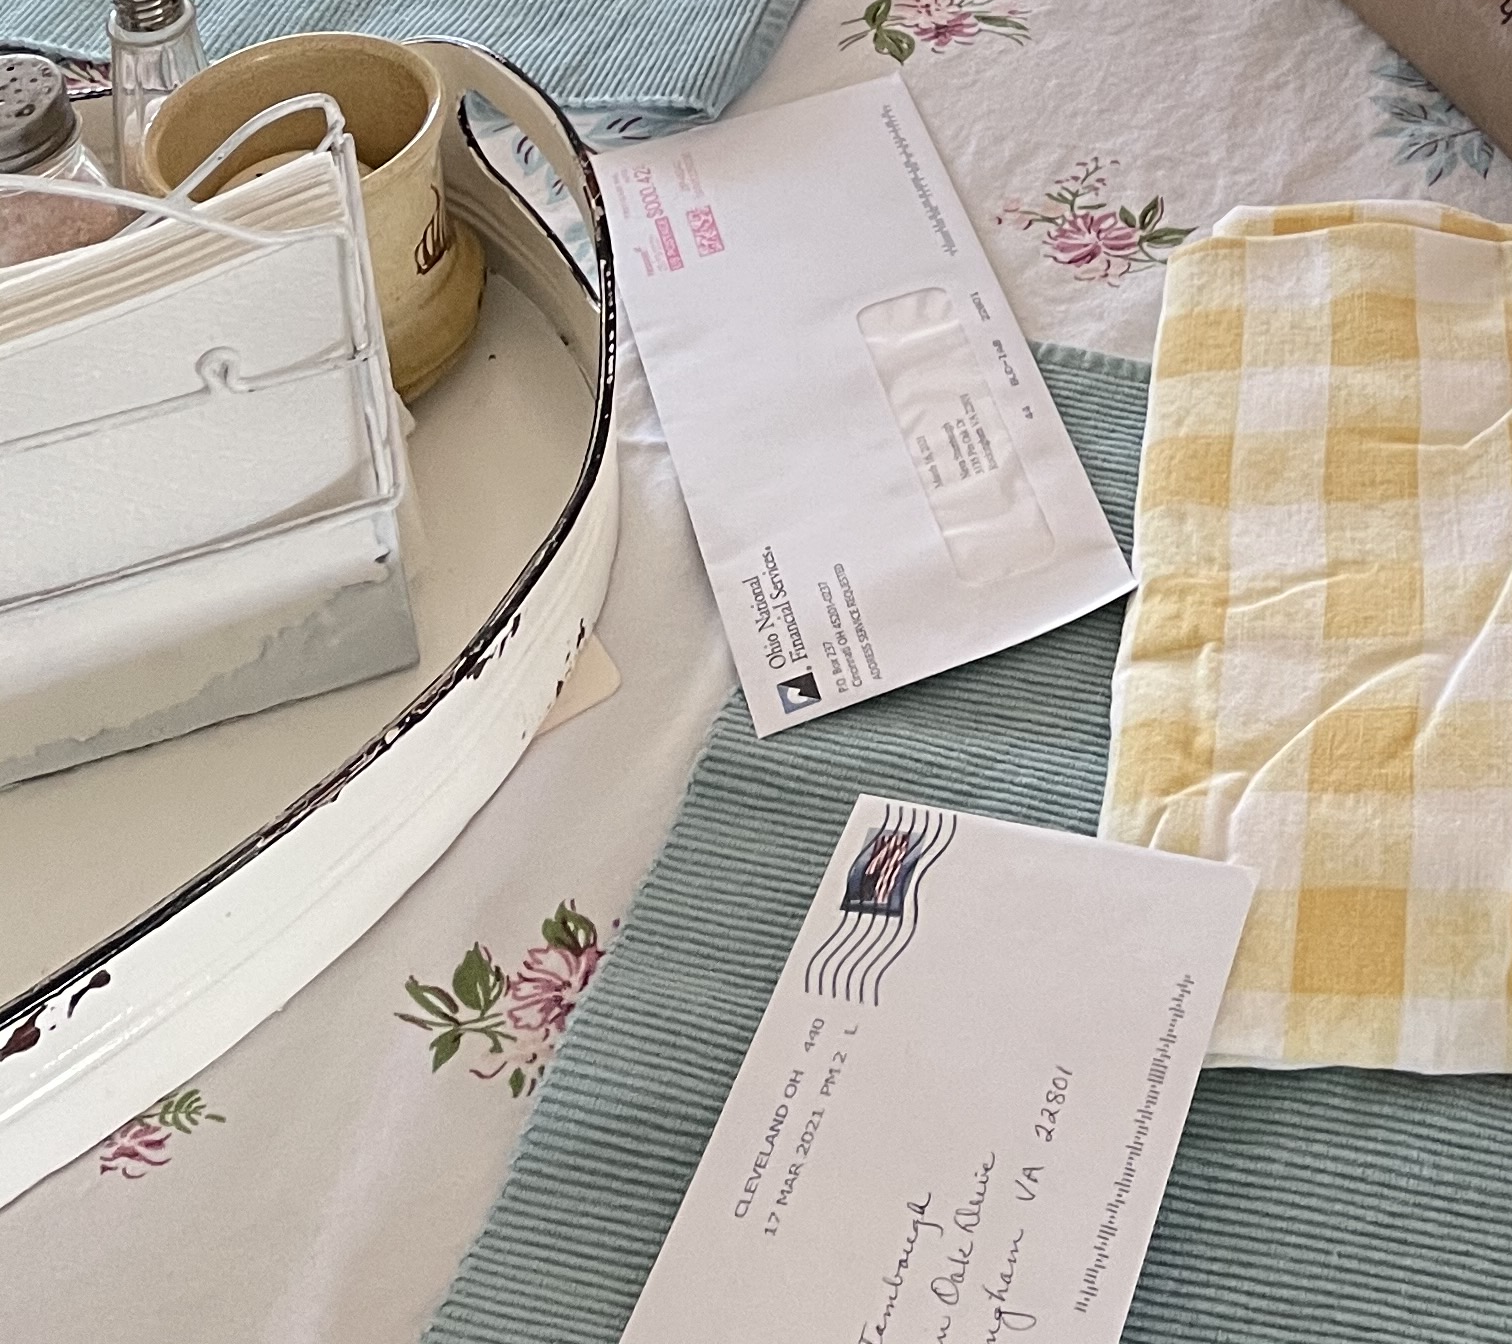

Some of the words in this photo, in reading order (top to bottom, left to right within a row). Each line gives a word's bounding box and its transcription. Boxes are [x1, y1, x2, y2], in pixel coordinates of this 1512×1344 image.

[742, 575, 775, 632] National
[834, 563, 857, 608] REQUESTED
[772, 600, 808, 663] Financial
[835, 630, 848, 645] OH
[849, 608, 869, 643] SERVICE
[764, 633, 786, 669] Ohio
[822, 642, 837, 658] 237
[831, 658, 842, 675] Box
[842, 646, 863, 687] Cincinnati
[861, 643, 882, 679] ADDRESS
[734, 1104, 788, 1218] CLEVELAND
[784, 1069, 804, 1099] OH
[804, 1018, 825, 1053] 440
[1015, 1165, 1045, 1201] VA
[1036, 1065, 1074, 1144] 22801
[764, 1212, 780, 1236] 17
[776, 1163, 804, 1206] MAR
[796, 1109, 825, 1156] 2021
[820, 1068, 841, 1096] PM
[930, 1240, 974, 1306] Oak
[953, 1150, 998, 1234] Drive
